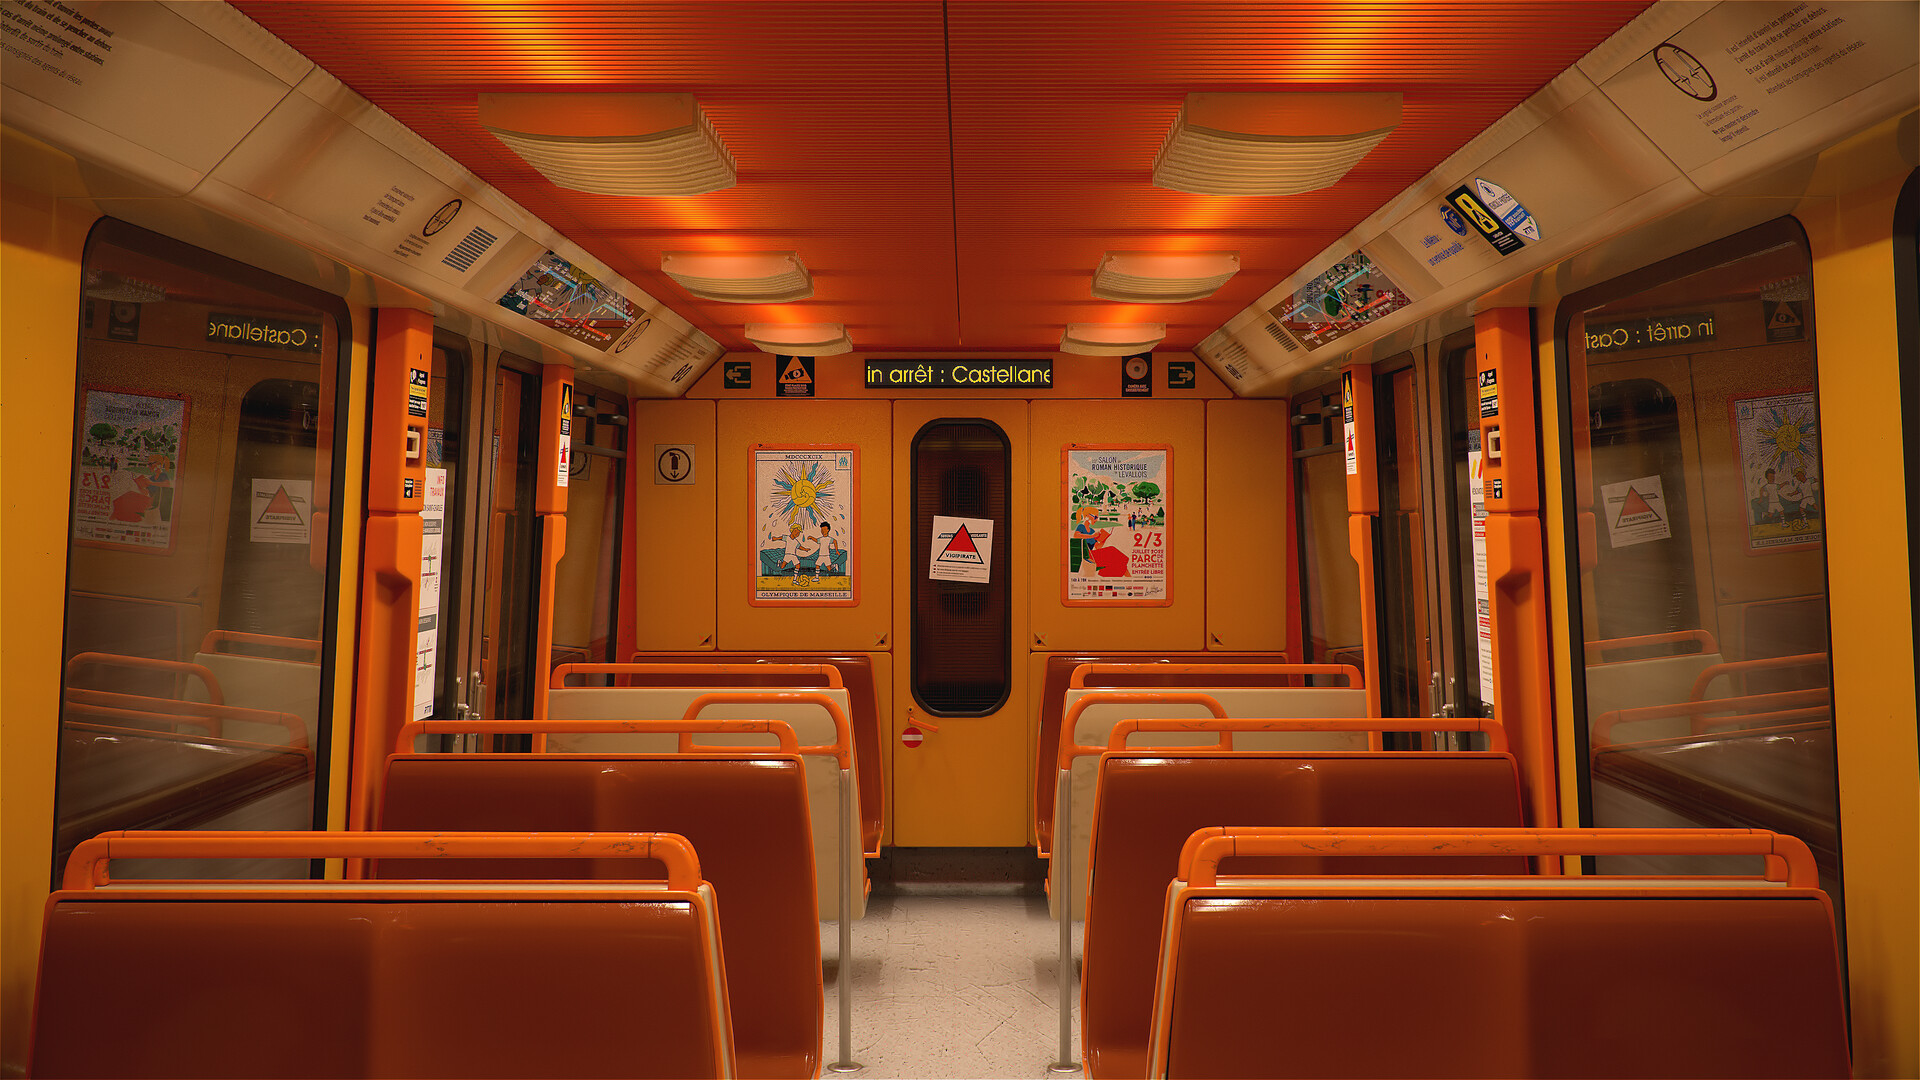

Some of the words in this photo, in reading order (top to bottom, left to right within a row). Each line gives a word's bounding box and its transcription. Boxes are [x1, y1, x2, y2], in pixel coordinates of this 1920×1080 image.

[868, 366, 882, 383] in
[890, 364, 933, 383] arrêt
[1134, 531, 1162, 548] 2/3
[1132, 554, 1156, 562] PARC
